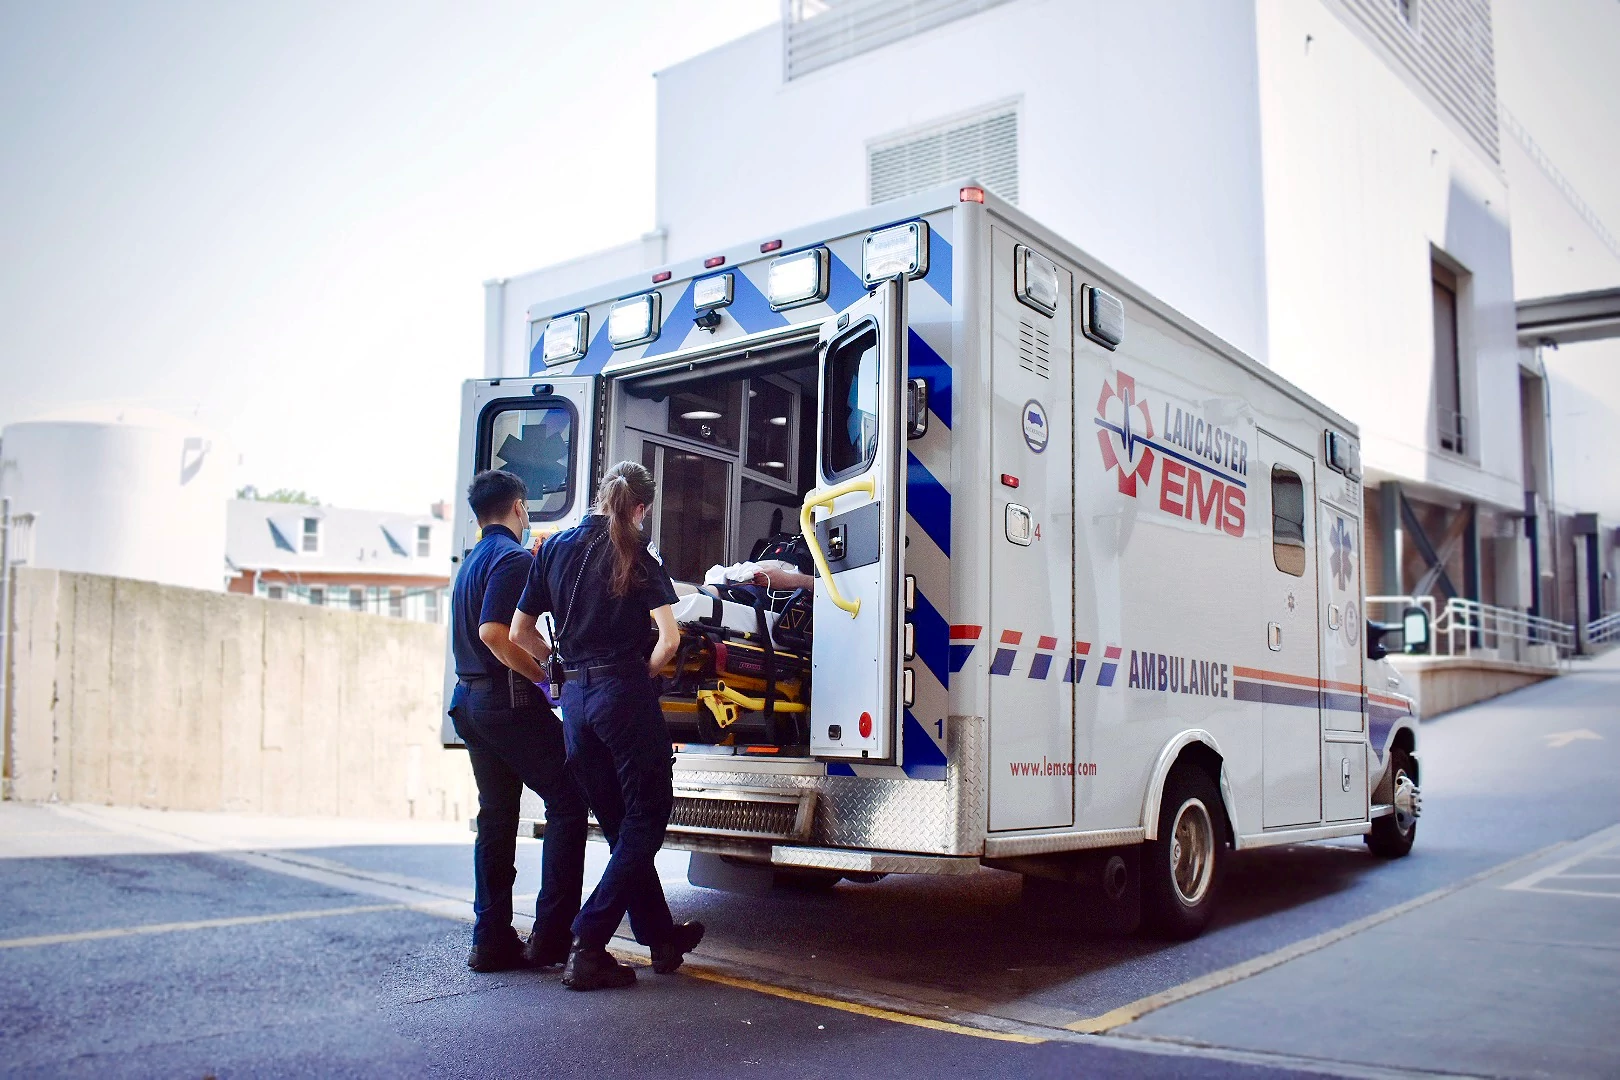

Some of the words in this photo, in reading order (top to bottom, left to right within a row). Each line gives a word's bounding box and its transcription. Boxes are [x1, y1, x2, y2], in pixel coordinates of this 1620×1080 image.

[1164, 402, 1247, 476] LANCASTER
[1160, 457, 1246, 538] EMS
[1034, 523, 1041, 541] 4
[1128, 650, 1228, 698] AMBULANCE
[934, 718, 943, 740] 1
